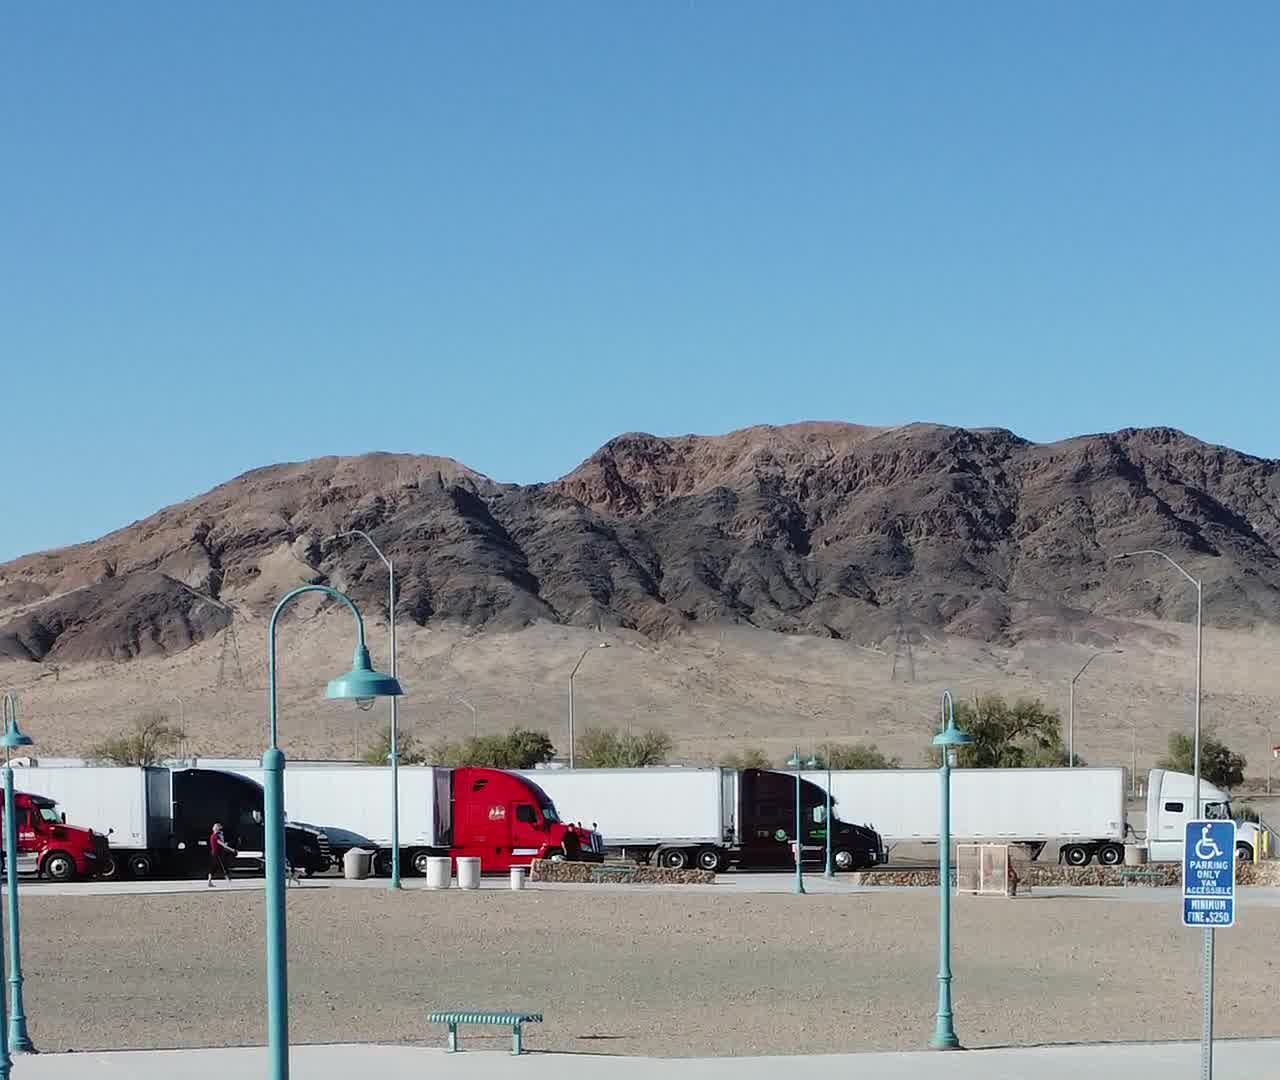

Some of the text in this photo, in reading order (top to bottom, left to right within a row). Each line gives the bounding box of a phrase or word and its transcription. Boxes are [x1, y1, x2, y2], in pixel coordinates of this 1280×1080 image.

[1189, 861, 1228, 870] PARKING
[1197, 870, 1221, 879] ONLY
[1186, 886, 1231, 894] ACCESSIBLE
[1191, 899, 1226, 910] MINIMUM
[1187, 911, 1230, 922] FINE $250
